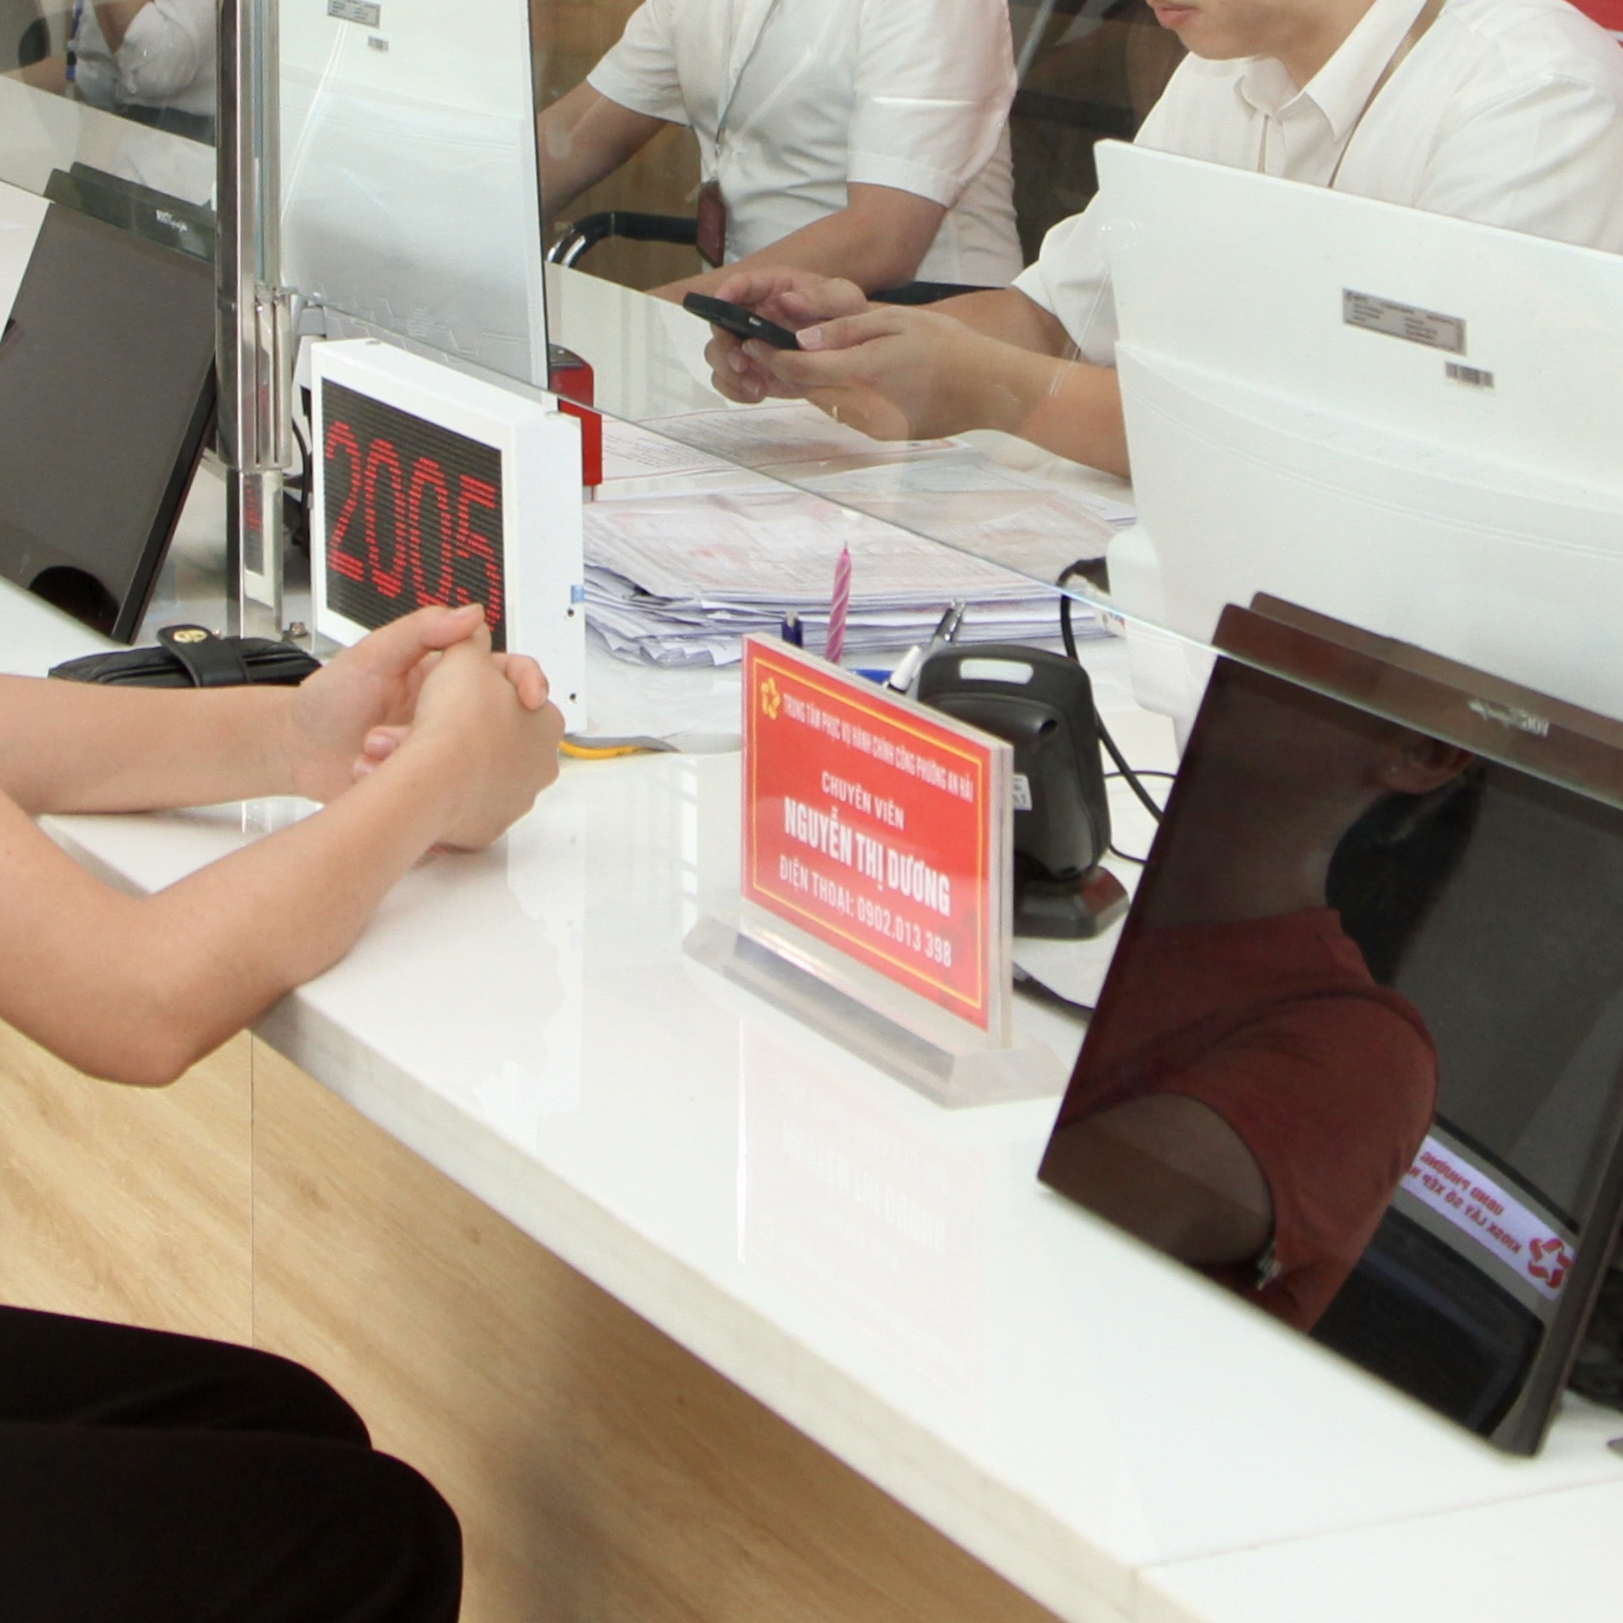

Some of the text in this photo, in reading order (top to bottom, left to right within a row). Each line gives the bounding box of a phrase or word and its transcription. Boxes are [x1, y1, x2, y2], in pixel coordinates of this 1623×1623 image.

[326, 420, 503, 632] 2005
[783, 796, 951, 917] NGUYỄN THỊ DƯƠNG
[821, 771, 905, 831] CHUYÊN VIÊN
[779, 855, 953, 968] ĐIỆN THOẠI: 0902.013 398
